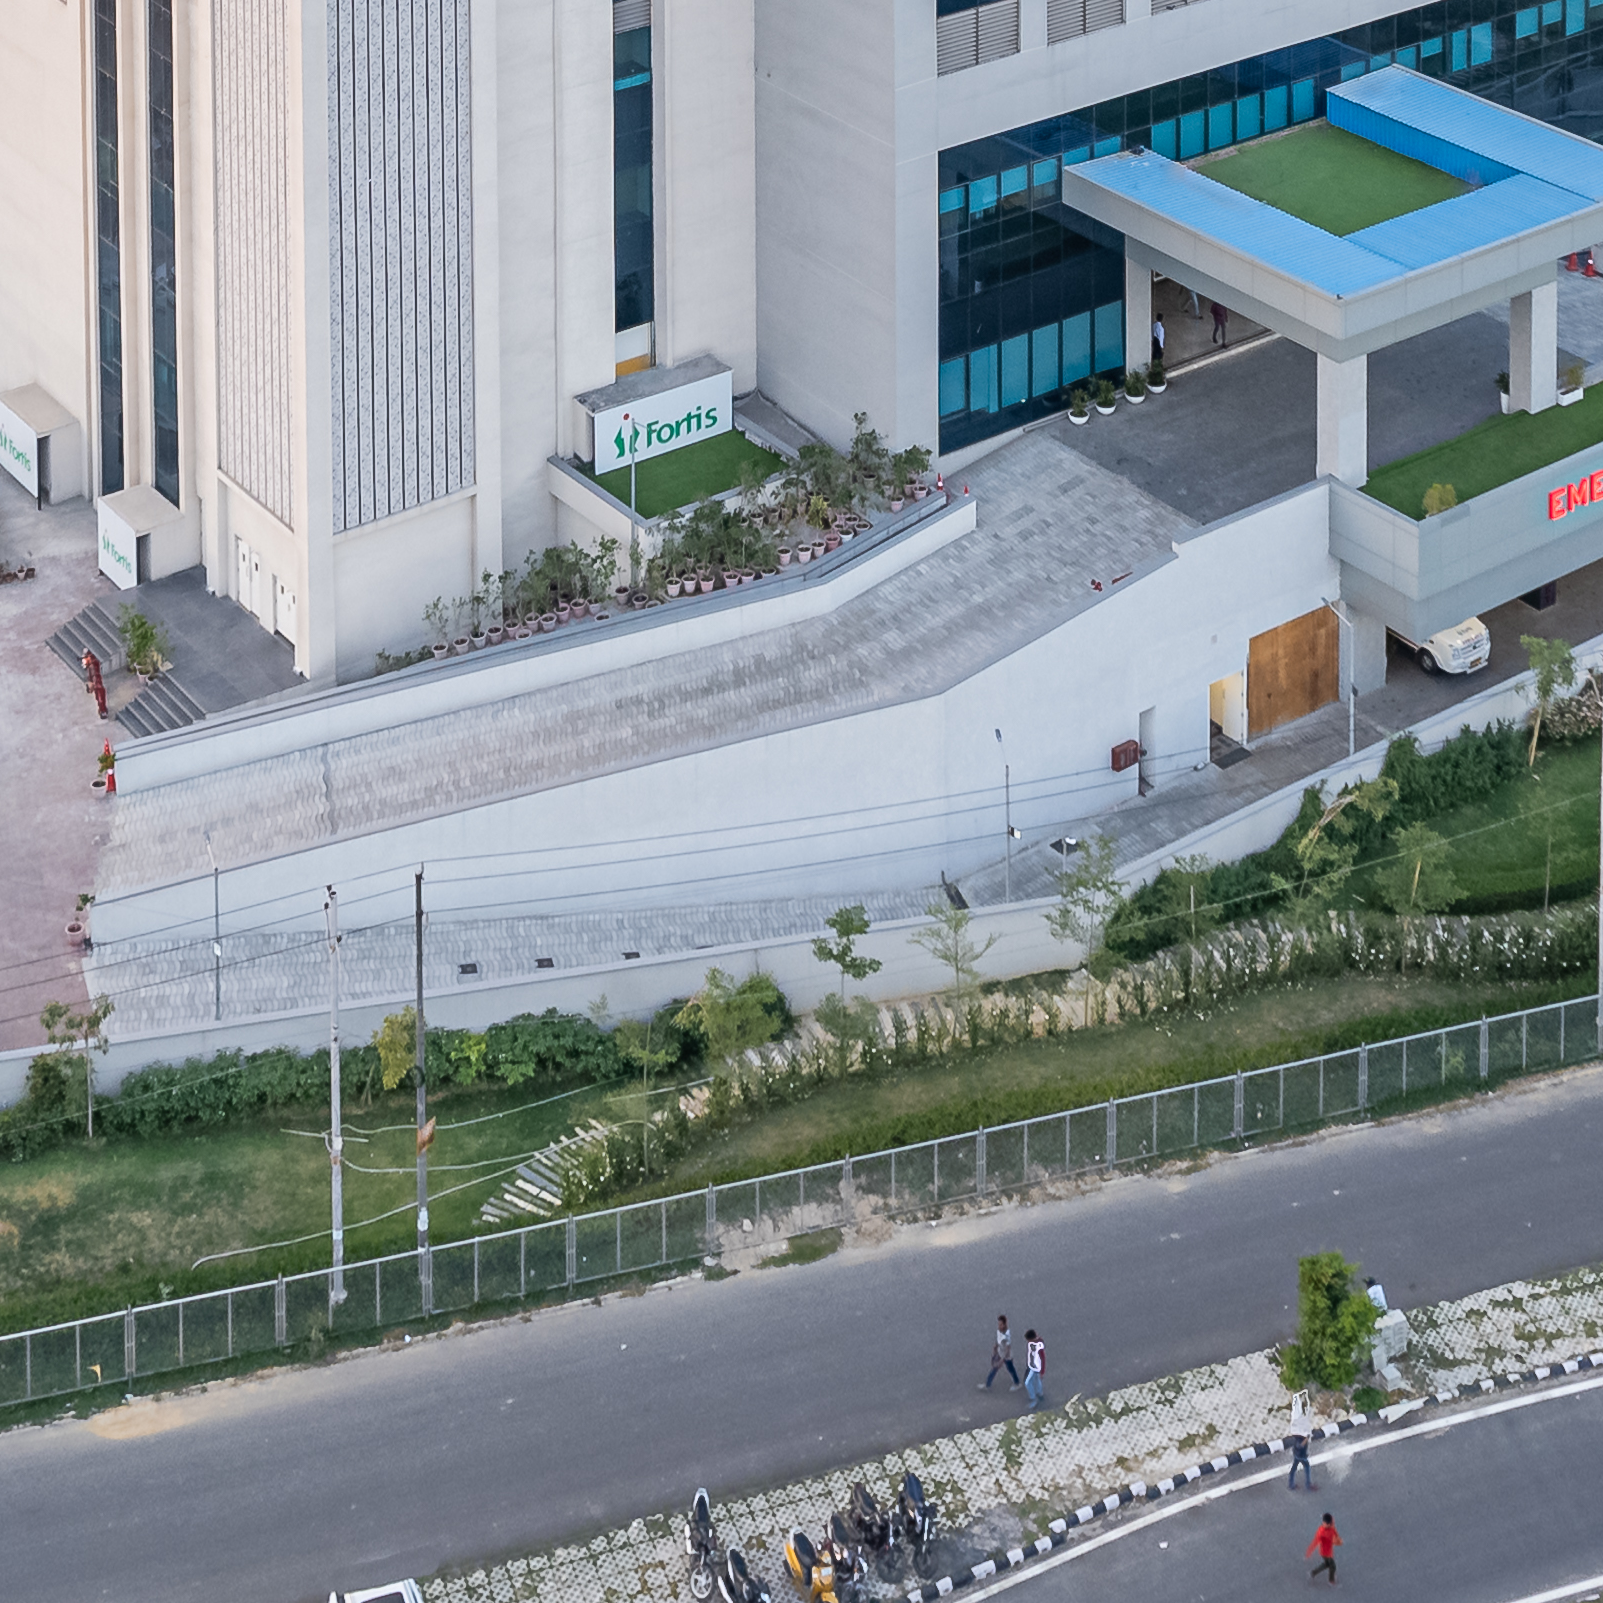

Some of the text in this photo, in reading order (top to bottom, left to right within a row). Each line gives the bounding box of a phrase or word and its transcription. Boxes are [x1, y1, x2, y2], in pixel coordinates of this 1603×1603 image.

[646, 405, 717, 449] Fortis
[8, 439, 31, 472] Fortis
[111, 543, 132, 574] Fortis
